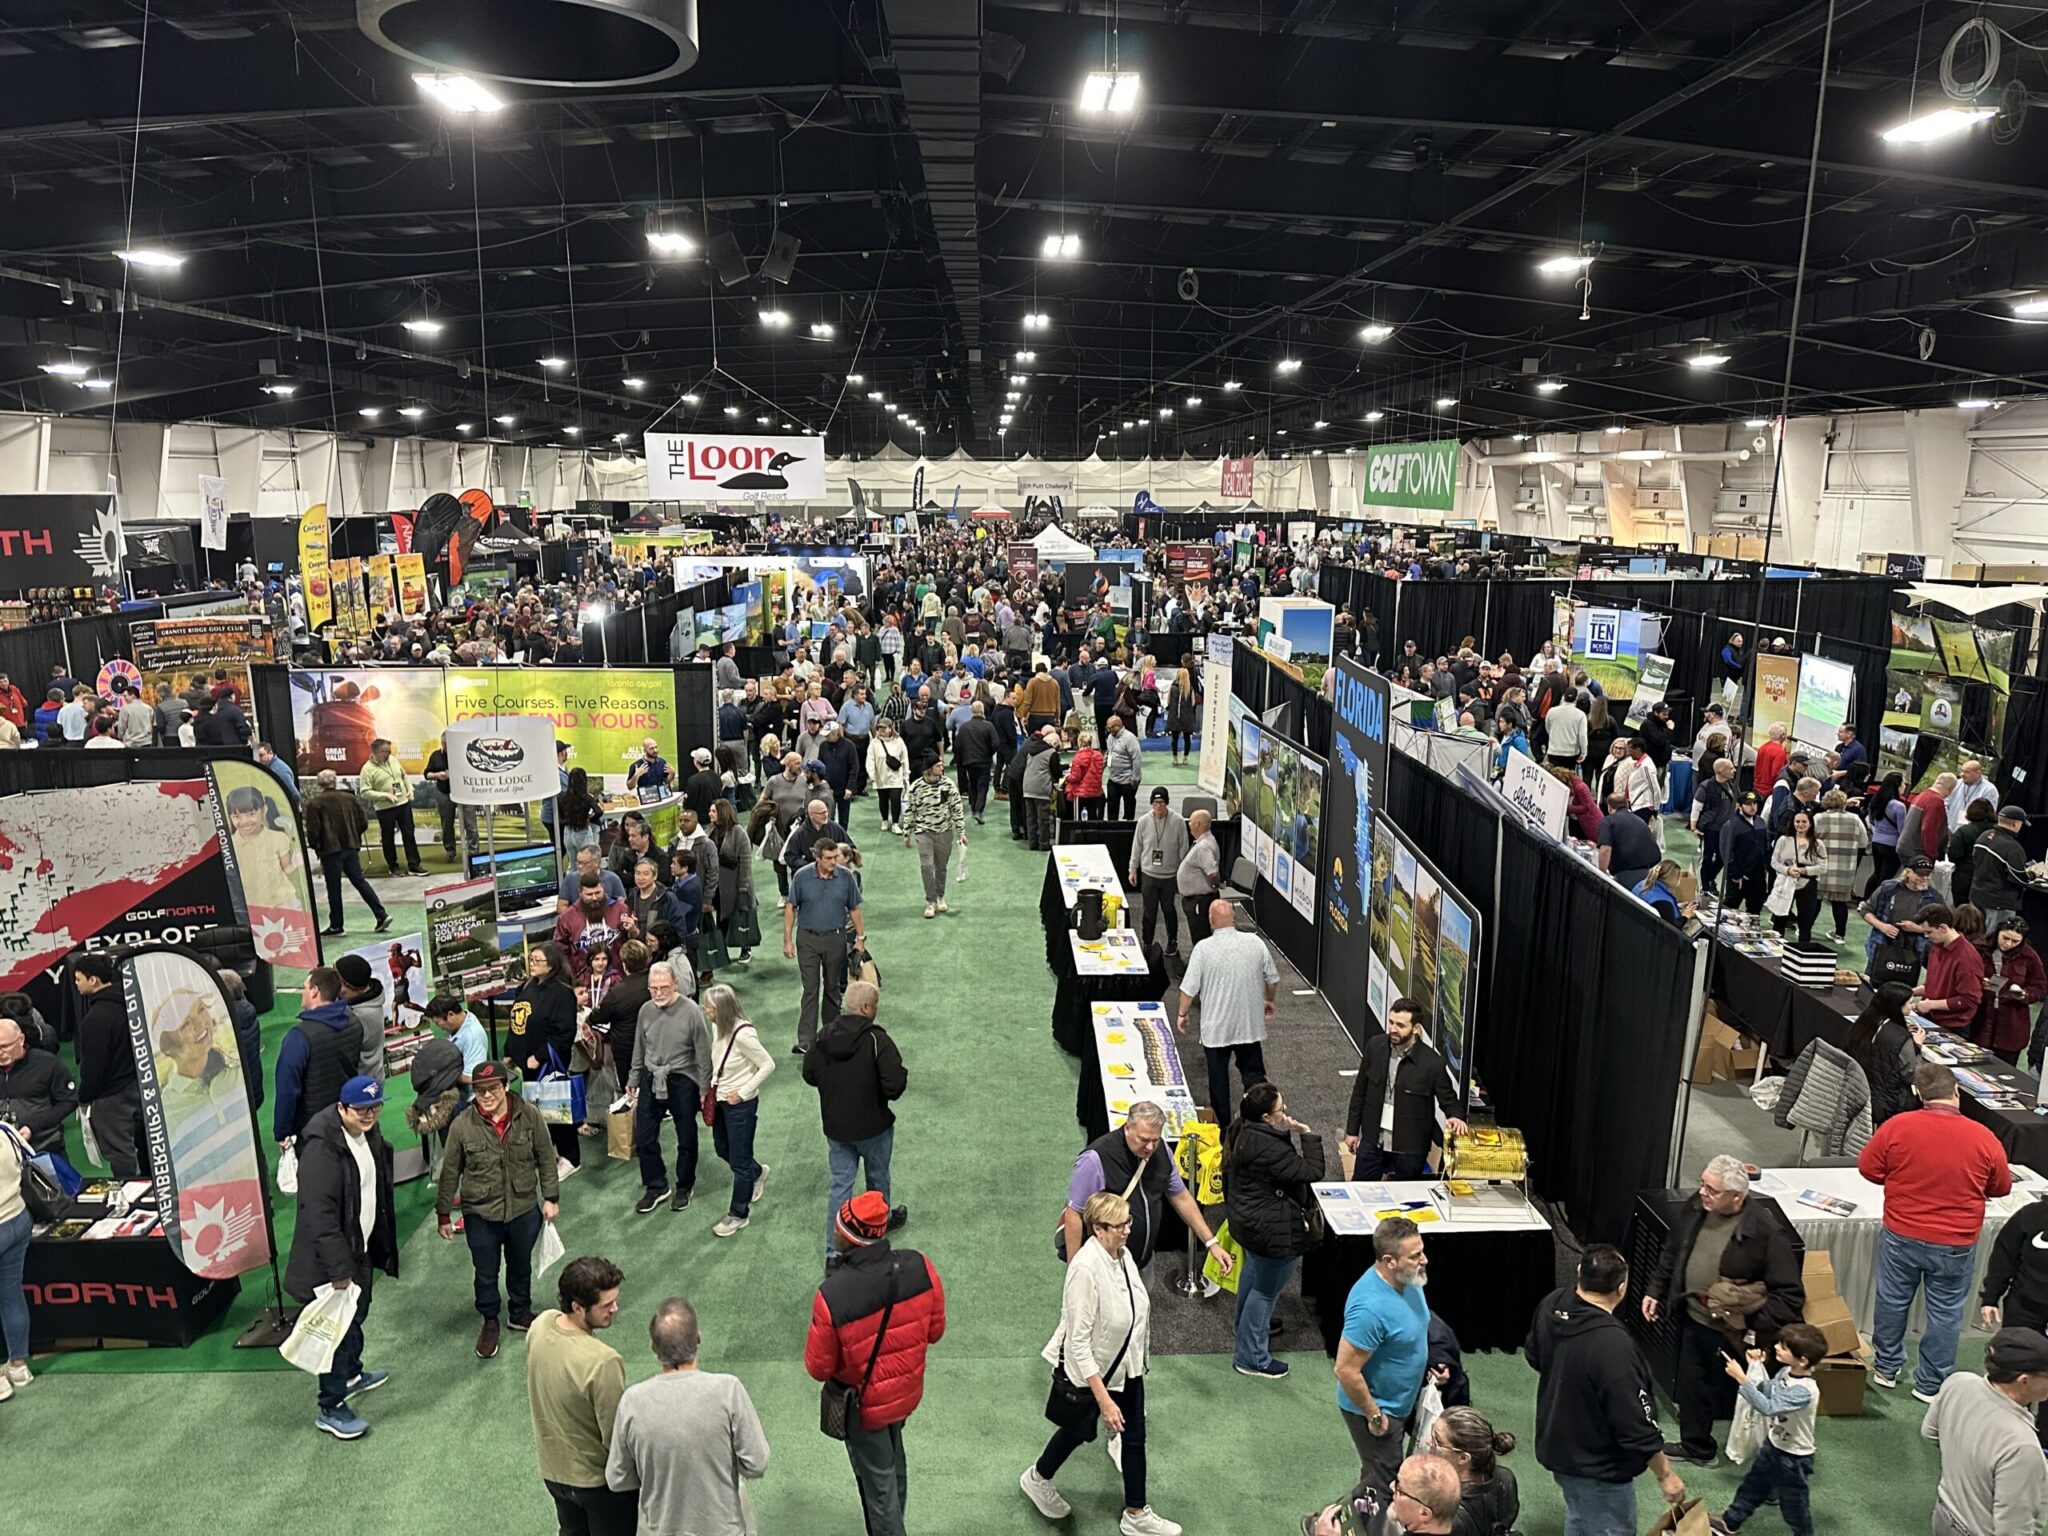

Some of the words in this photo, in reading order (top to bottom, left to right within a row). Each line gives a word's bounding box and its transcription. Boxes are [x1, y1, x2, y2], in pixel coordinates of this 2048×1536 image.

[668, 439, 685, 480] THE
[688, 441, 776, 481] Loon
[1033, 482, 1044, 490] Putt
[1045, 482, 1069, 492] Challenge
[1223, 473, 1236, 496] DEAL
[1237, 474, 1251, 496] ZONE
[743, 491, 759, 501] Golf
[761, 492, 788, 500] Resort
[161, 629, 187, 637] GRANITE
[188, 627, 208, 635] RIDGE
[210, 626, 226, 634] GOLF
[1590, 623, 1615, 641] TEN
[141, 658, 182, 674] Niagara
[184, 651, 249, 668] Escarpment
[607, 679, 662, 689] toronto.ca/golf
[1761, 673, 1790, 684] VIRGINIA
[1765, 687, 1786, 697] BEACH
[455, 695, 487, 709] Five
[493, 694, 559, 709] Courses.
[564, 695, 597, 709] Five
[600, 695, 669, 710] Reasons.
[1334, 667, 1384, 745] FLORIDA
[586, 712, 664, 729] YOURS.
[326, 753, 347, 761] VALUE
[463, 776, 496, 786] KELTIC
[499, 774, 533, 785] LODGE
[1521, 765, 1539, 781] THIS
[1538, 777, 1546, 797] IS
[1513, 786, 1547, 826] Alabama
[126, 905, 216, 922] GOLFNORTH
[434, 915, 477, 931] TWOSOME
[435, 926, 456, 938] GOLF
[458, 924, 465, 932] &
[465, 919, 487, 931] CART
[435, 935, 452, 944] FOR
[21, 1282, 178, 1309] NORTH
